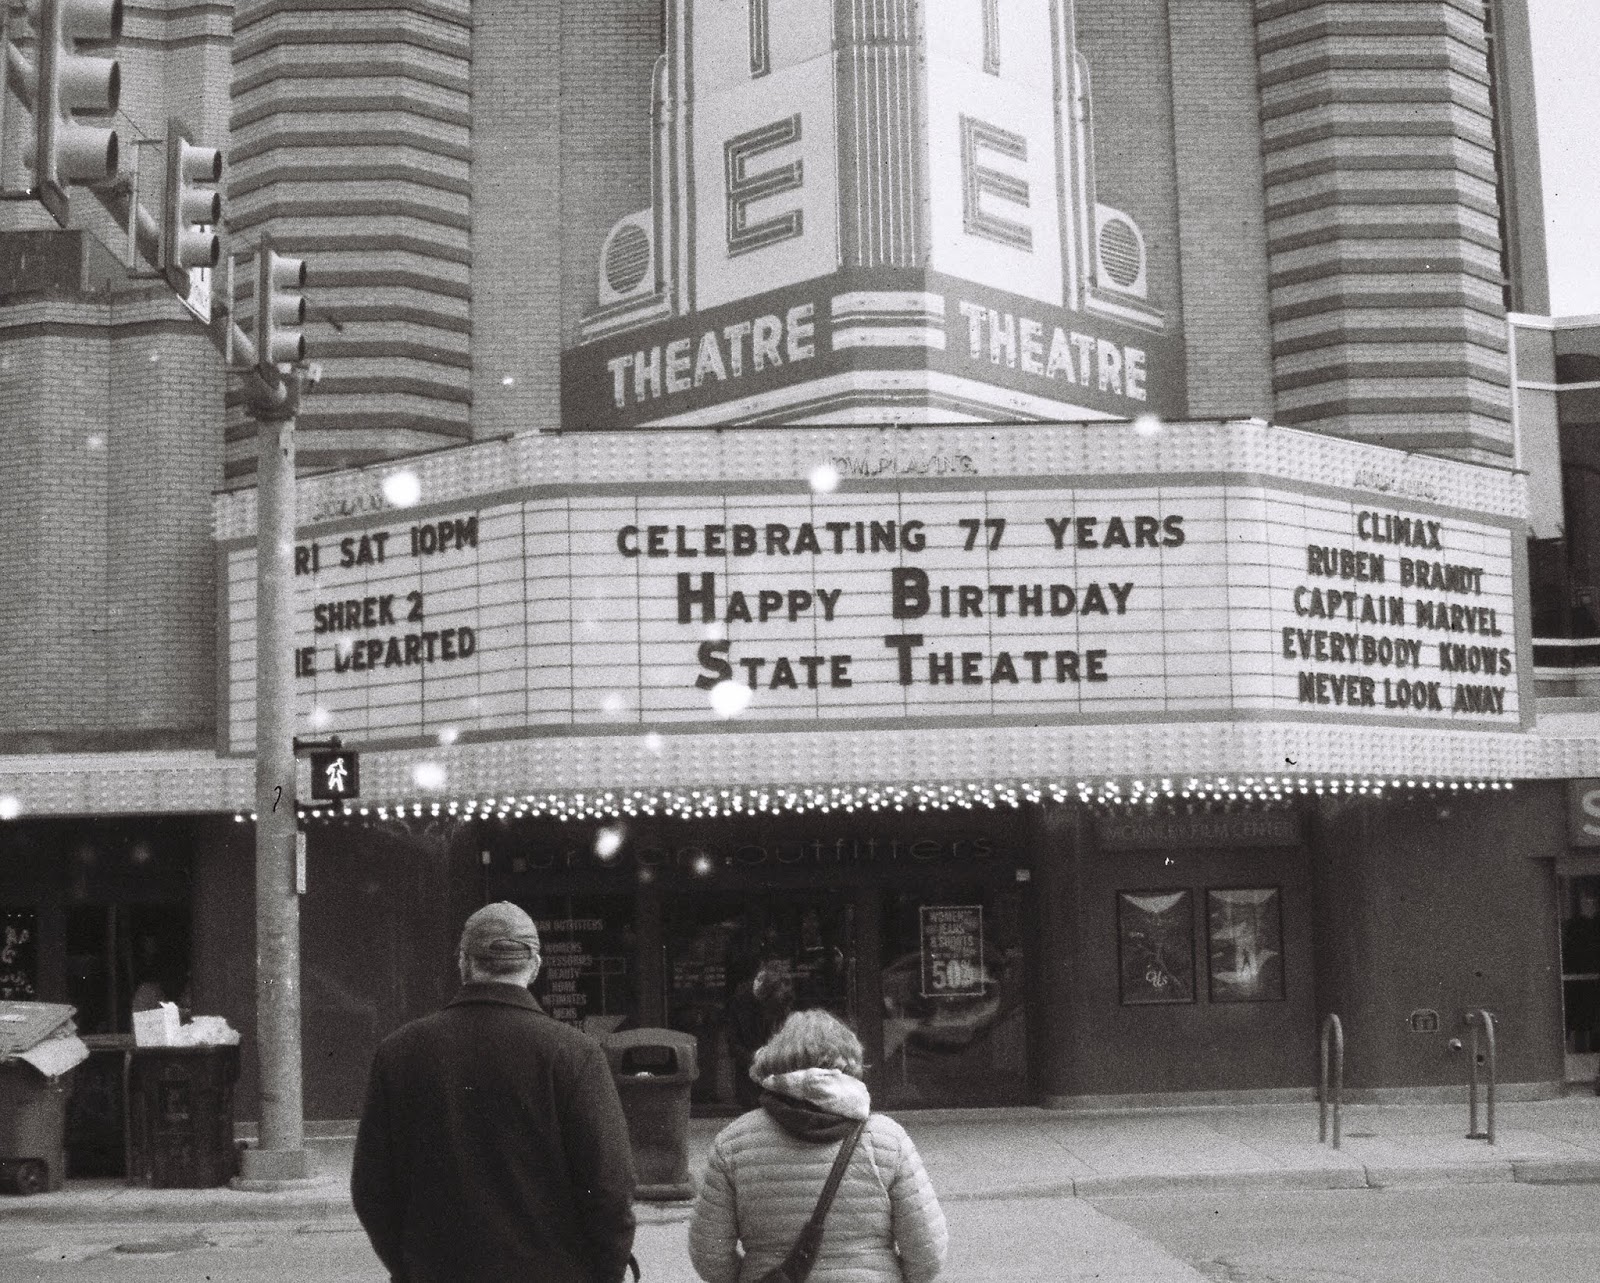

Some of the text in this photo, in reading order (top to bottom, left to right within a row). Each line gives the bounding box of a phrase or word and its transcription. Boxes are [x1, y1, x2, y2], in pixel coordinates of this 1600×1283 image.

[607, 302, 815, 409] THEATRE
[959, 299, 1147, 401] THEATRE
[340, 531, 389, 568] SAT
[616, 515, 1186, 558] CELEBRATING 77 YEARS
[1357, 510, 1442, 551] CLIMAX
[1307, 544, 1484, 596] RUBEN BRANDT
[313, 590, 424, 634] SHREK 2
[1293, 585, 1503, 638] CAPTAIN MARVEL
[1282, 626, 1512, 677] EVERYBODY KNOWS
[1298, 671, 1506, 715] NEVER LOOK AWAY
